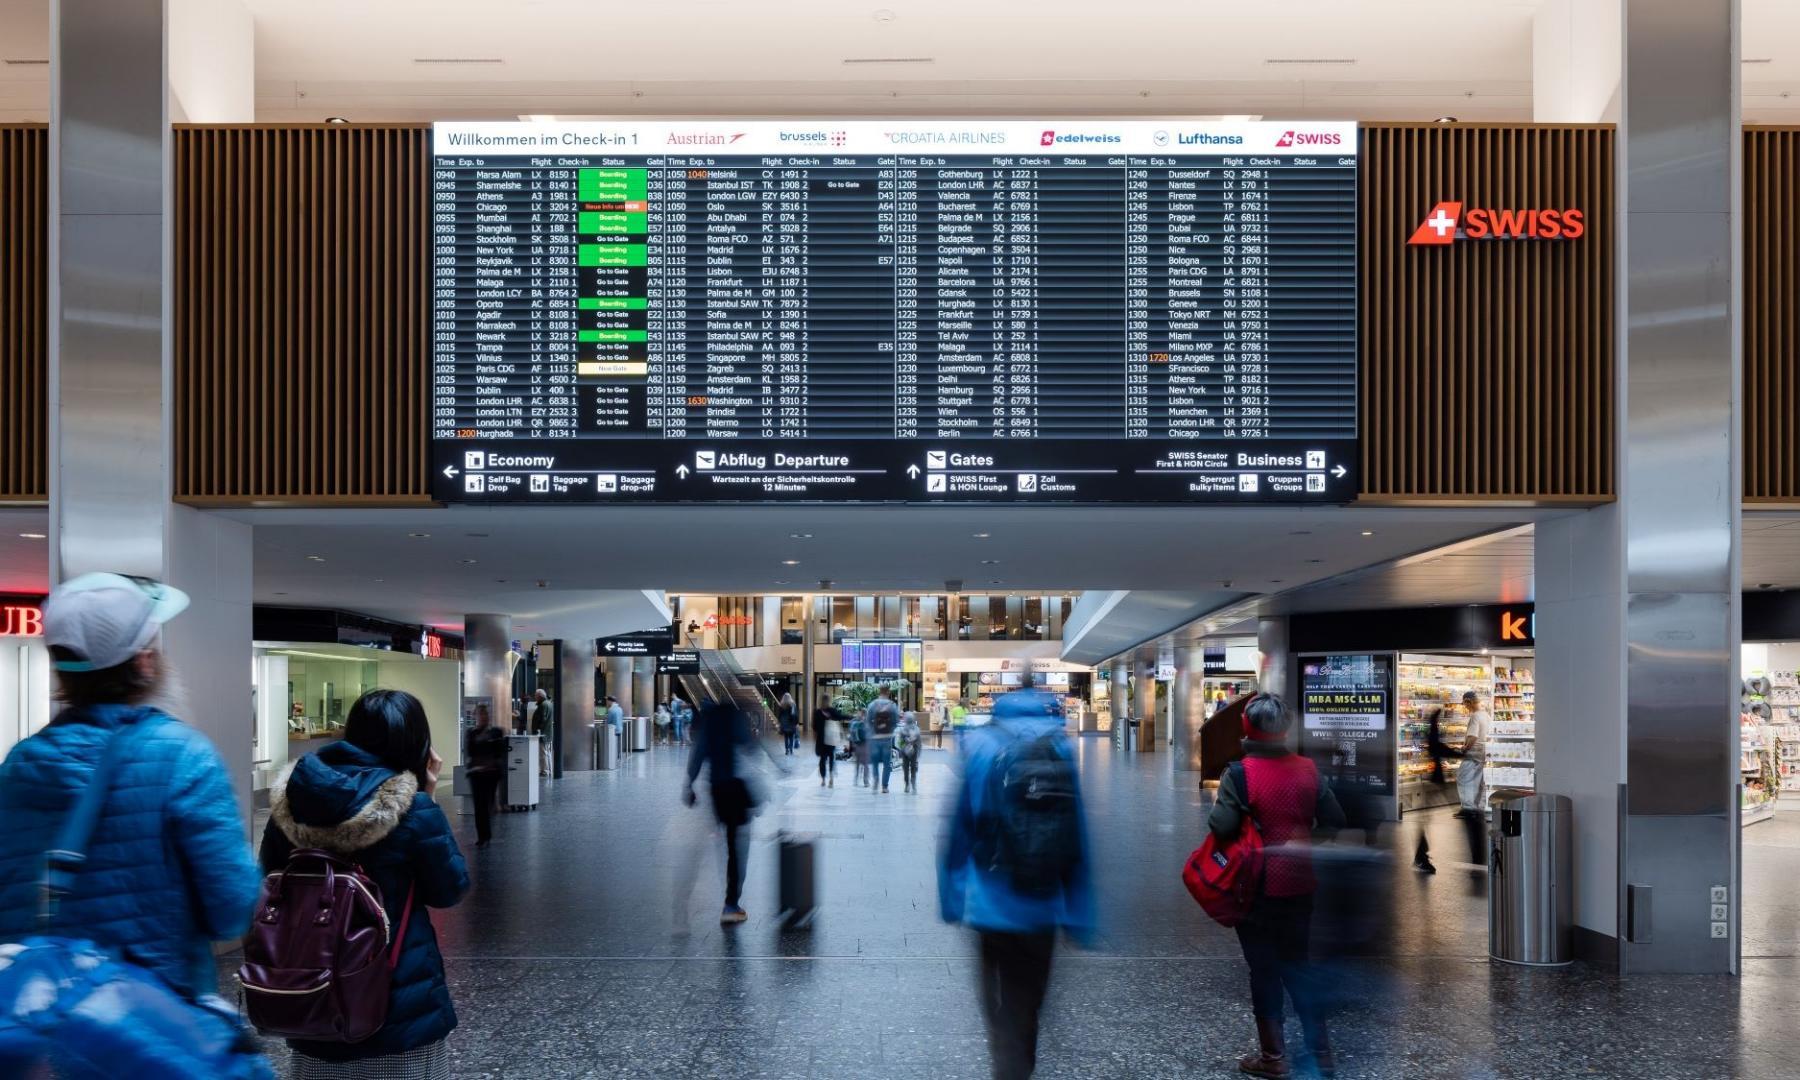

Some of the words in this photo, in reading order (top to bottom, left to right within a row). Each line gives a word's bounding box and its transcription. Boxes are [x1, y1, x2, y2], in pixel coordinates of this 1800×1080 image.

[448, 132, 537, 146] Willkommen
[541, 134, 557, 145] im
[562, 132, 626, 146] Check-in
[632, 134, 638, 145] 1
[667, 132, 725, 145] Austrian
[780, 131, 827, 141] brussels
[891, 132, 945, 144] CROATIA
[949, 132, 1005, 144] AIRLINES
[1056, 134, 1121, 143] edelweiss
[1178, 133, 1243, 145] Lufthansa
[1296, 133, 1341, 145] SWISS
[459, 158, 474, 167] Exp.
[531, 158, 552, 167] Flight
[436, 171, 455, 179] 0940
[476, 171, 500, 179] Marsa
[502, 171, 521, 179] Alam
[531, 171, 541, 179] LX
[549, 171, 569, 179] 8150
[648, 171, 663, 179] D43
[667, 170, 686, 178] 1050
[688, 170, 707, 178] 1040
[707, 170, 737, 178] Helsinki
[762, 170, 773, 178] CX
[780, 170, 799, 178] 1491
[878, 170, 893, 178] A83
[898, 170, 917, 178] 1205
[938, 170, 983, 180] Gothenburg
[993, 170, 1003, 178] LX
[1011, 170, 1030, 178] 1222
[1128, 170, 1147, 179] 1240
[1168, 170, 1210, 179] Dusseldorf
[1223, 170, 1235, 180] SQ
[1241, 170, 1260, 179] 2948
[1466, 208, 1584, 239] SWISS
[436, 236, 455, 244] 1000
[476, 236, 517, 244] Stockholm
[531, 236, 542, 244] SK
[549, 236, 569, 244] 3508
[647, 236, 663, 244] A62
[898, 332, 917, 340] 1225
[938, 332, 950, 340] Tel
[952, 332, 969, 340] Aviv
[993, 332, 1003, 340] LX
[1011, 332, 1026, 340] 252
[667, 343, 686, 351] 1145
[707, 343, 753, 353] Philadelphia
[762, 343, 774, 351] AA
[780, 343, 795, 351] 093
[878, 343, 893, 351] E35
[1128, 354, 1147, 362] 1310
[1149, 354, 1168, 362] 1720
[1168, 354, 1182, 362] Los
[1184, 354, 1214, 364] Angeles
[1223, 354, 1235, 362] UA
[1241, 354, 1261, 362] 9730
[667, 397, 686, 405] 1155
[688, 397, 707, 405] 1630
[707, 397, 752, 407] Washington
[762, 397, 773, 405] LH
[780, 397, 799, 405] 9310
[436, 430, 455, 438] 1045
[457, 430, 476, 438] 1200
[476, 430, 513, 440] Hurghada
[531, 430, 541, 438] LX
[549, 430, 569, 438] 8134
[898, 430, 917, 438] 1240
[938, 430, 960, 438] Berlin
[993, 430, 1004, 438] AC
[1011, 430, 1030, 438] 6766
[1128, 429, 1147, 437] 1320
[1168, 429, 1199, 439] Chicago
[1223, 429, 1235, 437] UA
[1241, 429, 1261, 437] 9726
[488, 454, 554, 469] Economy
[718, 453, 766, 469] Abflug
[774, 454, 849, 469] Departure
[950, 453, 994, 466] Gates
[1237, 453, 1302, 466] Business
[506, 476, 521, 485] Bag
[553, 476, 588, 485] Baggage
[620, 476, 655, 485] Baggage
[1200, 476, 1235, 484] Sperrgut
[1268, 476, 1302, 484] Gruppen
[620, 484, 654, 492] drop-off
[979, 484, 1008, 492] Lounge
[1190, 484, 1212, 492] Bulky
[1273, 484, 1302, 492] Groups
[1308, 695, 1332, 703] MBA
[1334, 695, 1356, 703] MSC
[1358, 695, 1381, 703] LLM
